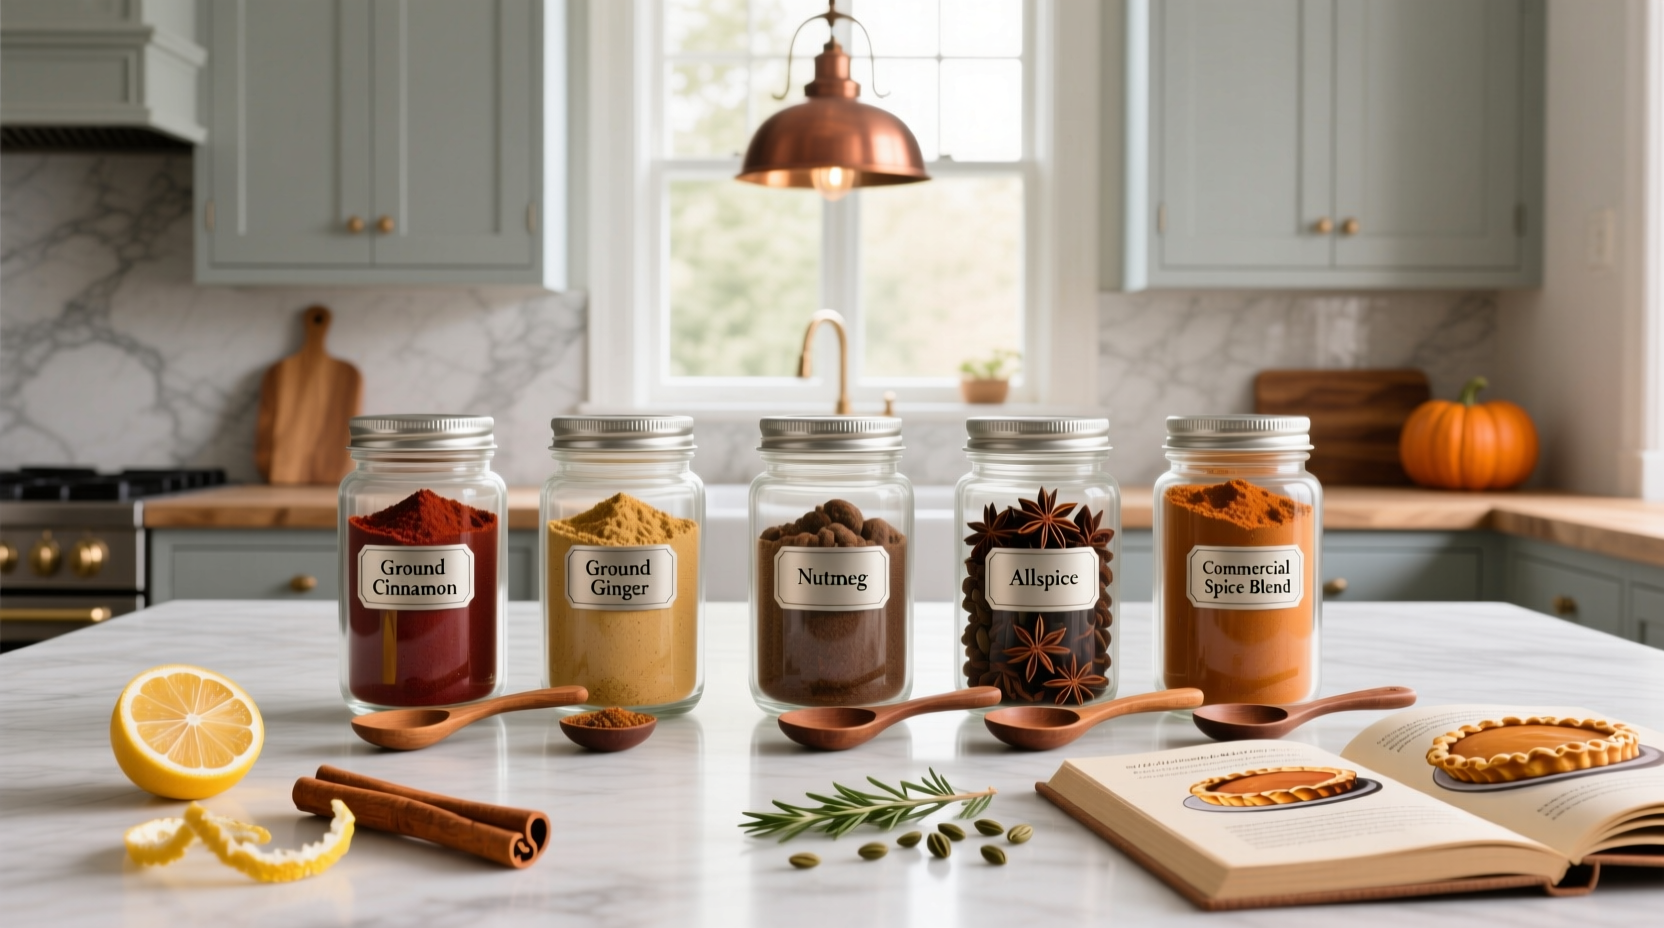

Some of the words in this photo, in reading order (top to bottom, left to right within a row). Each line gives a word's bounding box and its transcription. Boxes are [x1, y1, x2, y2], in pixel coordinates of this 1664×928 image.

[380, 558, 446, 576] Ground
[585, 558, 652, 576] Ground
[1202, 559, 1290, 576] Commercial
[372, 578, 458, 596] Cinnamon
[797, 567, 869, 591] Nutmeg
[1008, 568, 1079, 592] Allspice
[1204, 578, 1245, 599] Spice
[1249, 578, 1291, 595] Blend
[590, 578, 650, 601] Ginger
